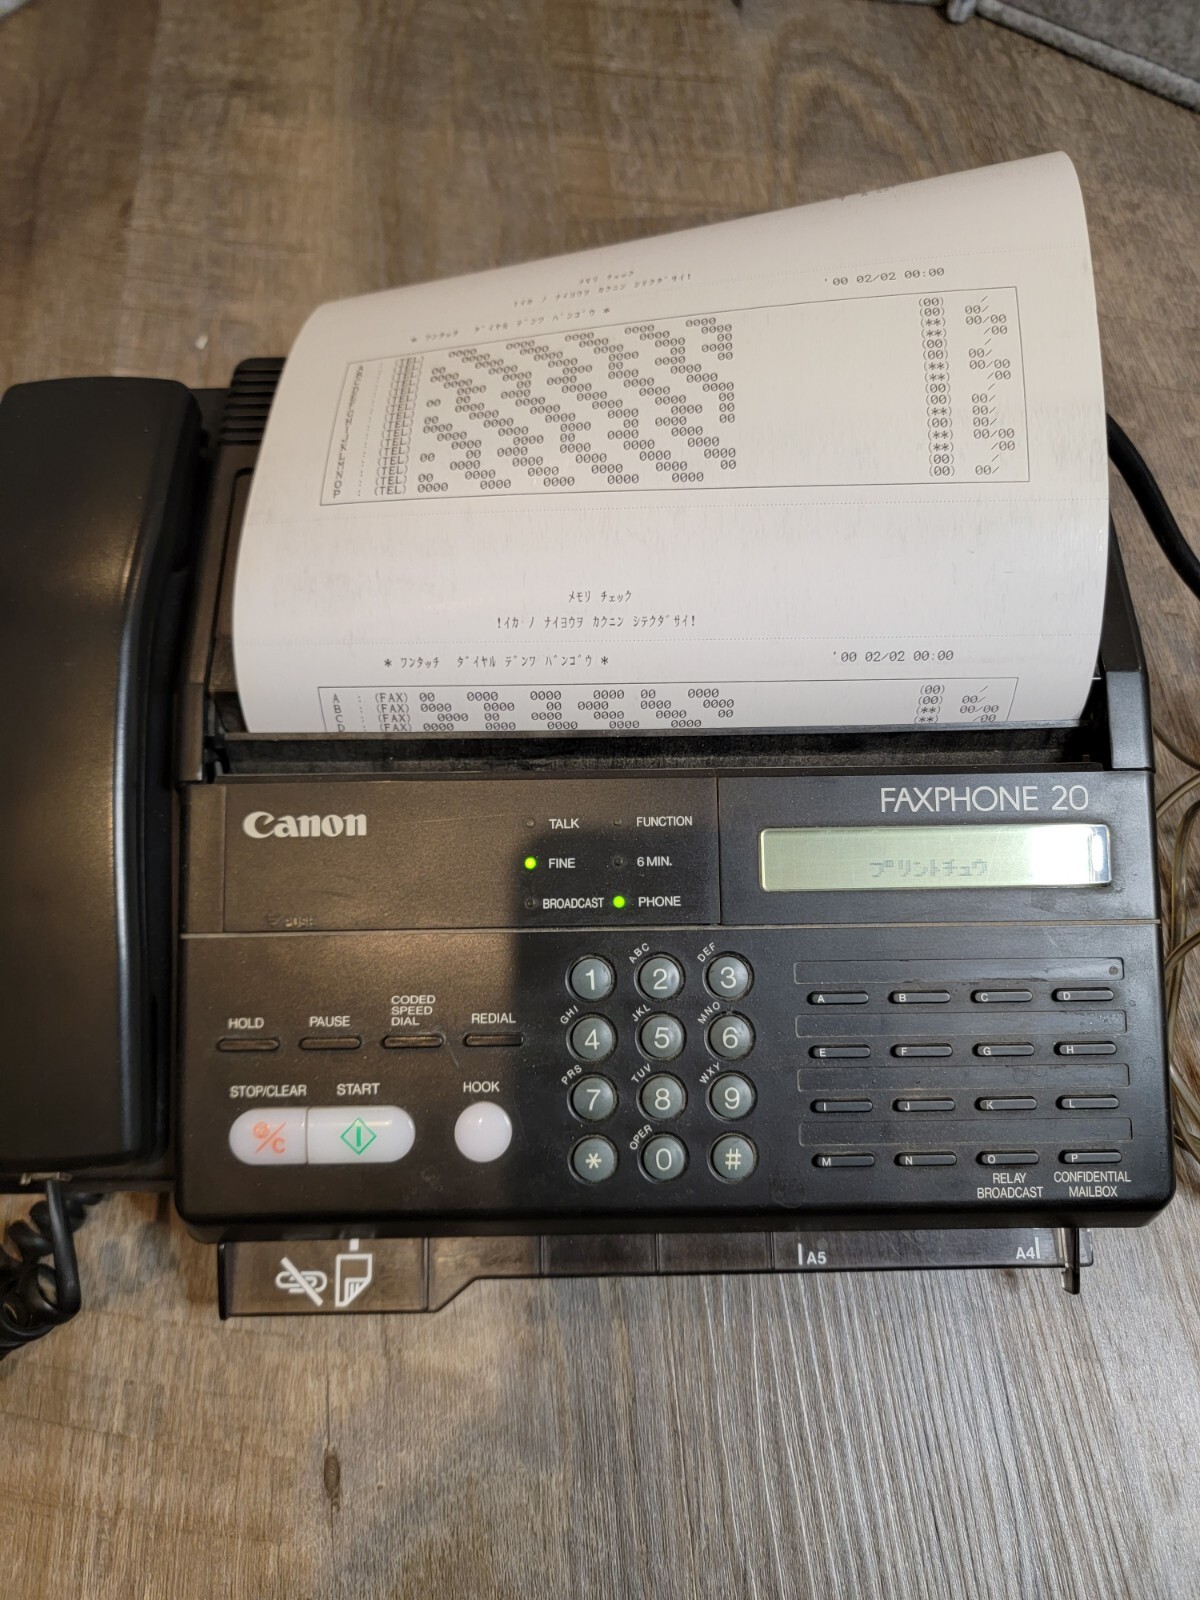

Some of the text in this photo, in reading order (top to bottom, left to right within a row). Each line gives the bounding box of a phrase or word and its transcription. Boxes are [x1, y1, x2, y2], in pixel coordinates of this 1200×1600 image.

[856, 271, 897, 284] 02/02
[904, 267, 945, 279] 00:00
[449, 459, 481, 471] 0000
[512, 456, 544, 467] 0000
[575, 452, 607, 464] 0000
[639, 450, 672, 462] 0000
[703, 447, 736, 459] 0000
[418, 473, 434, 483] 00
[464, 469, 496, 480] 0000
[527, 466, 559, 477] 0000
[591, 463, 623, 475] 0000
[655, 461, 688, 472] 0000
[720, 459, 737, 470] 00
[928, 453, 955, 465] (00)
[417, 482, 449, 493] 0000
[479, 478, 512, 490] 0000
[543, 476, 575, 487] 0000
[607, 473, 639, 485] 0000
[671, 471, 704, 483] 0000
[929, 465, 955, 477] (00)
[568, 590, 632, 603] メモリ チェック
[544, 616, 584, 629] ナイヨウヲ
[593, 616, 624, 628] カクニン
[400, 654, 592, 669] ワンタッチ ダイヤル デンワ バンゴウ
[865, 650, 905, 662] 02/02
[913, 650, 954, 662] 00:00
[333, 684, 945, 704] A (FAX) 00 0000 0000 0000 00 0000 (00)
[333, 704, 342, 714] B
[376, 703, 410, 714] (FAX)
[420, 702, 452, 713] 0000
[483, 702, 515, 712] 0000
[546, 701, 562, 711] 00
[577, 700, 609, 711] 0000
[640, 699, 672, 710] 0000
[702, 698, 735, 709] 0000
[918, 695, 943, 706] (00)
[335, 704, 999, 723] C (FAX) 0000 00 0000 0000 0000 00 00/00
[422, 721, 456, 732] 0000
[484, 720, 518, 731] 0000
[546, 720, 580, 731] 0000
[608, 719, 642, 729] 0000
[670, 718, 704, 728] 0000
[880, 785, 1089, 813] FAXPHONE 20
[243, 811, 367, 839] Canon
[549, 818, 580, 829] TALK
[636, 815, 693, 828] FUNCTION
[548, 857, 576, 869] FINE
[637, 856, 673, 868] 6 MIN.
[542, 897, 605, 910] BROADCAST
[638, 895, 682, 908] PHONE
[628, 942, 650, 965] ABC
[697, 942, 716, 963] DEF
[585, 969, 595, 990] 1
[653, 968, 668, 990] 2
[720, 966, 737, 988] 3
[391, 995, 436, 1005] CODED
[817, 994, 826, 1003] A
[899, 993, 906, 1003] B
[980, 992, 989, 1002] C
[1063, 992, 1071, 1001] D
[391, 1006, 433, 1016] SPEED
[560, 1005, 579, 1025] GHI
[632, 1004, 651, 1022] JKL
[697, 1001, 721, 1025] MNO
[228, 1017, 265, 1030] HOLD
[309, 1016, 351, 1028] PAUSE
[391, 1017, 420, 1027] DIAL
[471, 1012, 517, 1025] REDIAL
[584, 1029, 600, 1050] 4
[654, 1027, 670, 1048] 5
[722, 1027, 738, 1048] 6
[819, 1048, 826, 1058] E
[901, 1047, 907, 1057] F
[983, 1046, 991, 1056] G
[1066, 1045, 1074, 1055] H
[561, 1064, 582, 1085] PRS
[631, 1063, 651, 1084] TUV
[699, 1062, 721, 1084] WXY
[229, 1085, 307, 1099] STOP/CLEAR
[336, 1083, 380, 1096] START
[463, 1081, 500, 1094] HOOK
[586, 1089, 601, 1111] 7
[654, 1088, 671, 1111] 8
[724, 1087, 740, 1109] 9
[1069, 1099, 1075, 1109] L
[904, 1101, 910, 1111] J
[986, 1100, 994, 1110] K
[629, 1124, 653, 1151] OPER
[655, 1148, 672, 1171] 0
[821, 1156, 832, 1167] M
[905, 1156, 913, 1165] N
[987, 1155, 996, 1165] O
[1071, 1154, 1078, 1164] P
[993, 1173, 1027, 1184] RELAY
[1053, 1171, 1132, 1184] CONFIDENTIAL
[977, 1187, 1044, 1199] BROADCAST
[1069, 1186, 1118, 1198] MAILBOX
[806, 1251, 827, 1265] A5
[1015, 1247, 1035, 1260] A4
